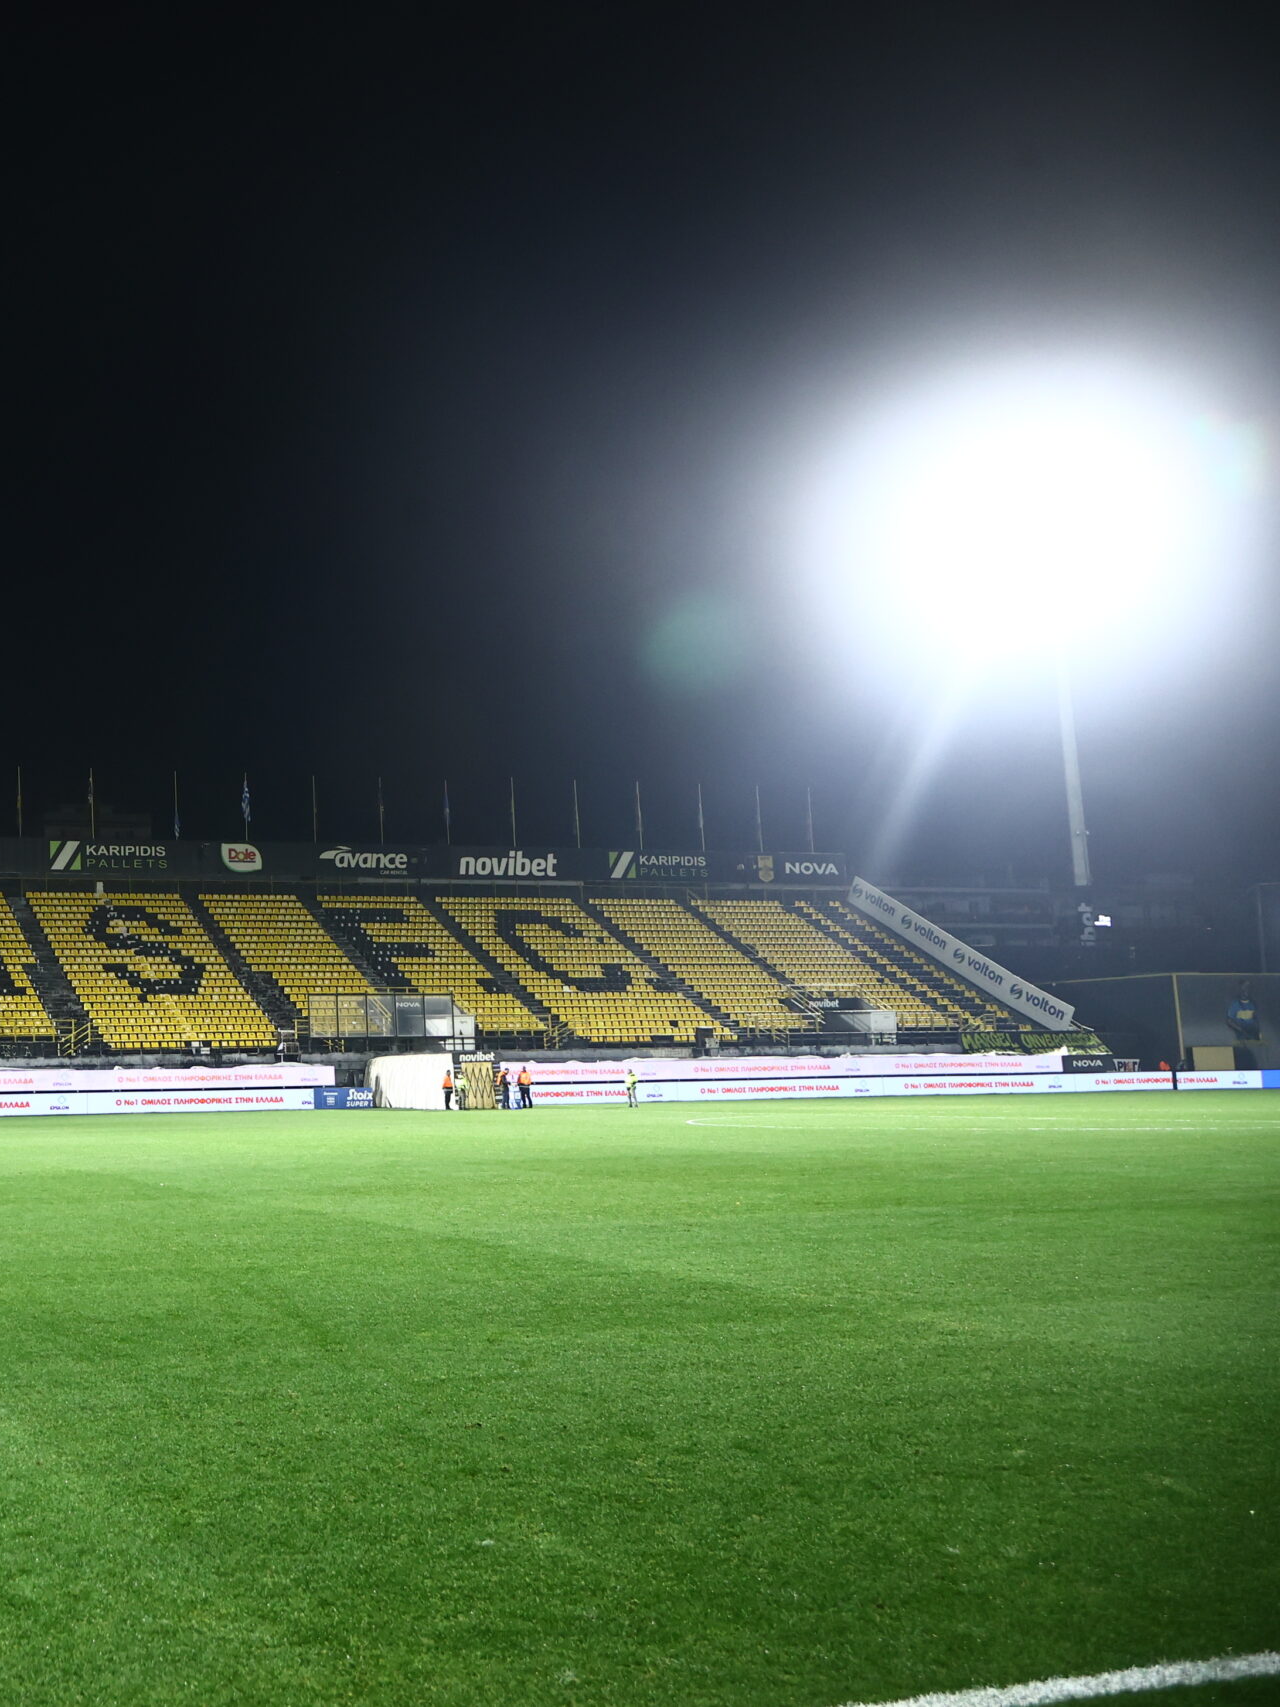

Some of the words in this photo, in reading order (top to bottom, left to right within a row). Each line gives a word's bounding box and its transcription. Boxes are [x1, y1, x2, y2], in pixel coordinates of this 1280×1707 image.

[86, 845, 166, 857] KARIPIDIS
[228, 848, 256, 861] Dole
[86, 859, 168, 869] PALLETS
[335, 851, 408, 869] avance
[459, 850, 558, 877] novibet
[639, 855, 707, 867] KARIPIDIS
[640, 868, 709, 878] PALLETS
[785, 862, 839, 875] NOVA
[865, 890, 895, 916] volton
[914, 922, 947, 950] volton
[968, 956, 1004, 985] volton
[1025, 992, 1065, 1020] volton
[459, 1052, 496, 1062] novibet
[1072, 1060, 1103, 1068] NOVA
[346, 1089, 374, 1100] Stoix
[0, 1101, 31, 1109] ΕΛΛΑΔΑ
[141, 1098, 171, 1106] ΟΜΙΛΟΣ
[235, 1096, 254, 1104] ΣΤΗΝ
